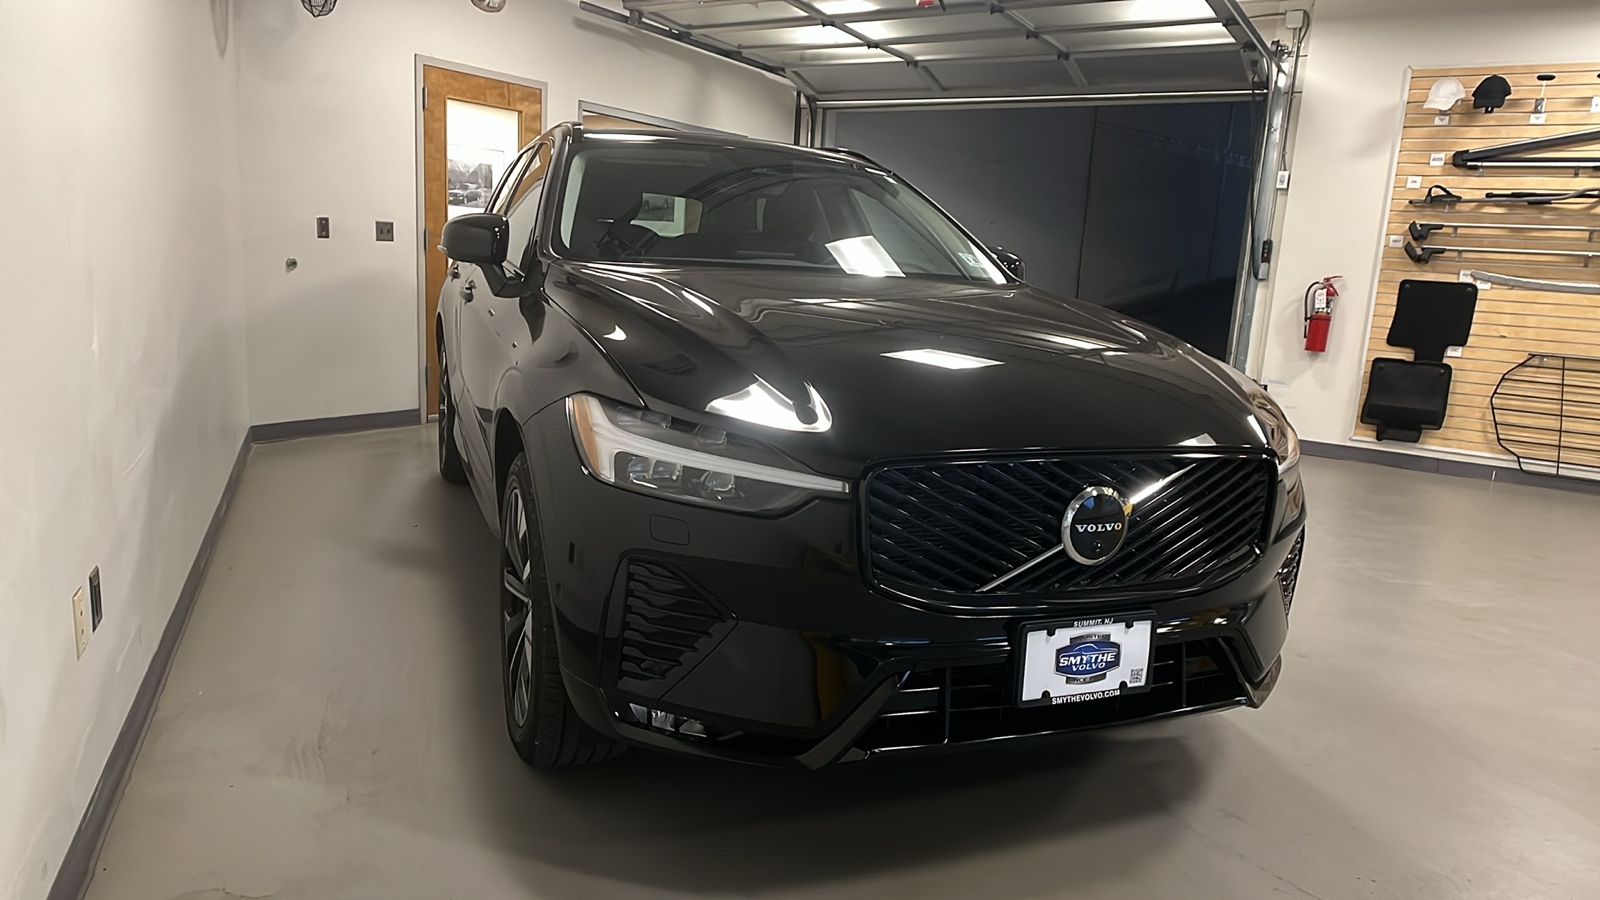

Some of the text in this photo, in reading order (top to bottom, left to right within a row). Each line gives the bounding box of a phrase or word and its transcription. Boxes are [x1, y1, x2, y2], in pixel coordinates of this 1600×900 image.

[1075, 522, 1122, 533] VOLVO
[1059, 652, 1117, 666] SMYTHE
[1072, 662, 1106, 671] VOLVO
[1052, 689, 1120, 705] SMYTHEVOLVO.COM
